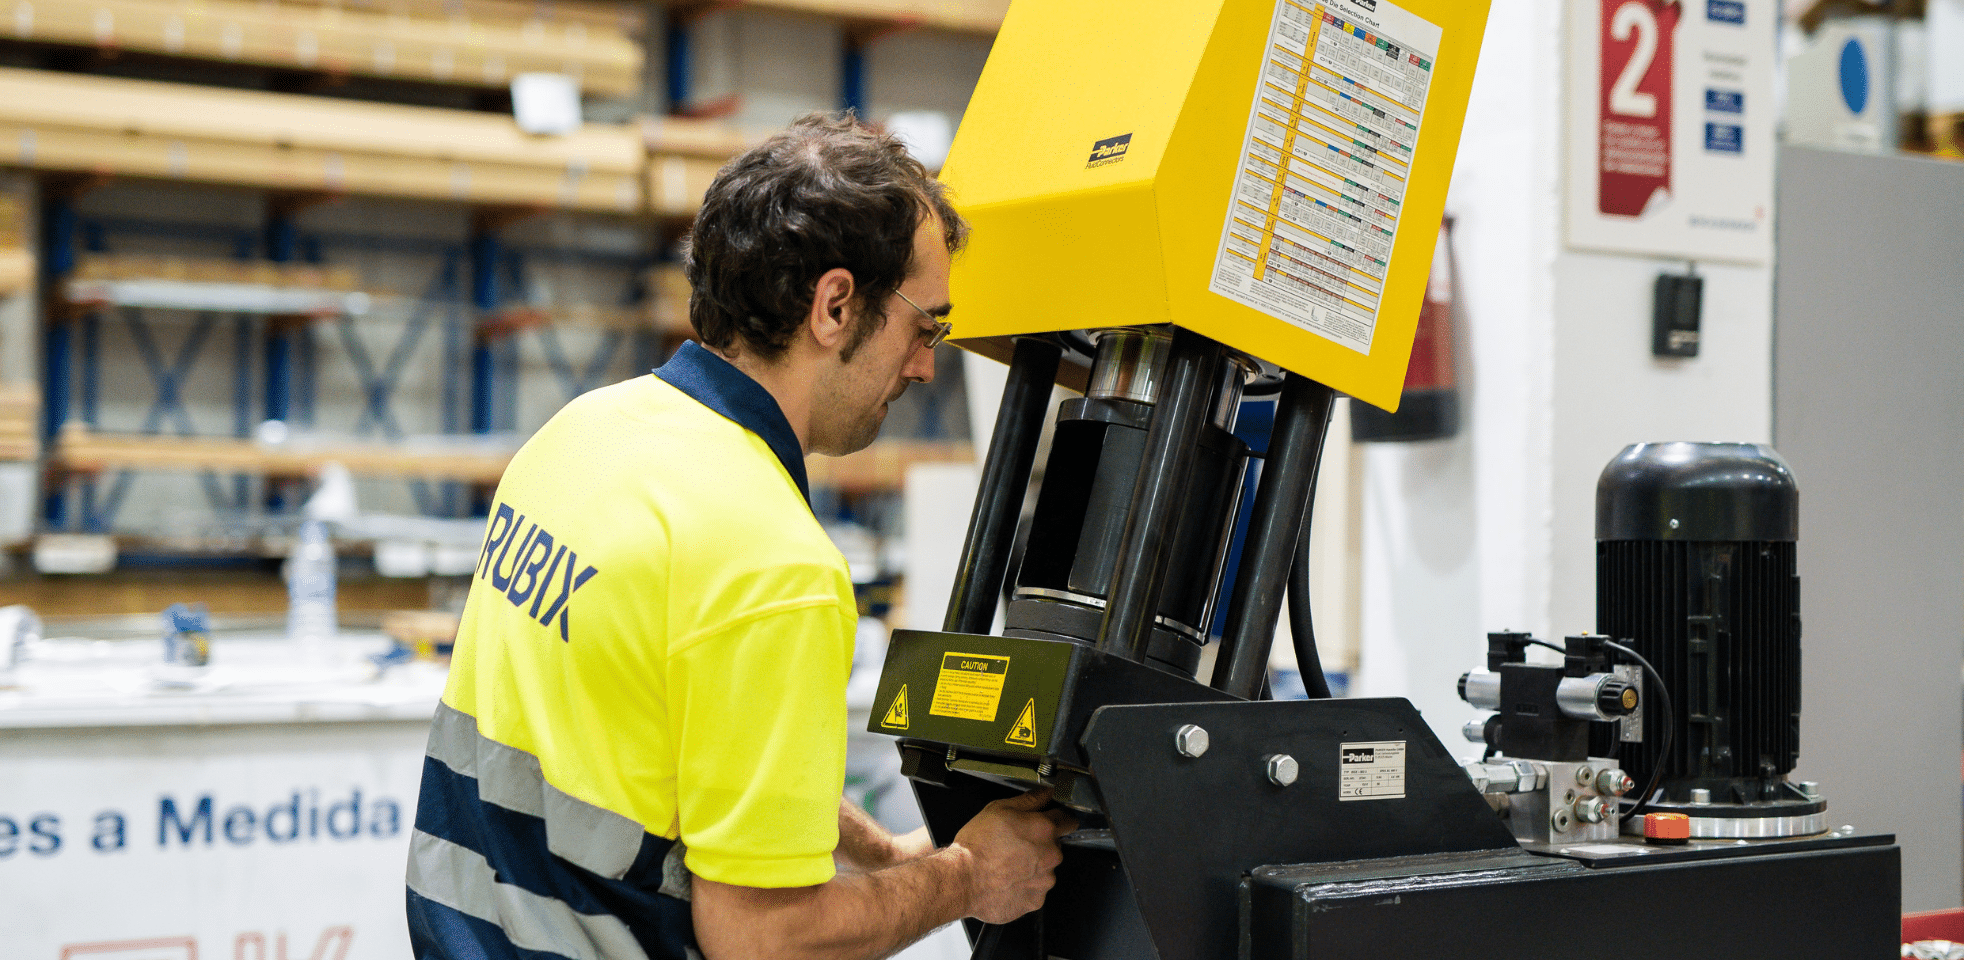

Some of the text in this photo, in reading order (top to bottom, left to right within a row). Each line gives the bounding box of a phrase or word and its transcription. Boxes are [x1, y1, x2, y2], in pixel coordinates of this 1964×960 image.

[1340, 4, 1364, 20] Selection
[1364, 16, 1380, 28] Chart
[1610, 1, 1658, 117] 2
[1094, 142, 1129, 157] Parker
[476, 502, 598, 643] RUBIX
[960, 660, 988, 671] CAUTION
[1348, 752, 1374, 763] Parker
[92, 810, 126, 854] a
[157, 787, 402, 847] Medida
